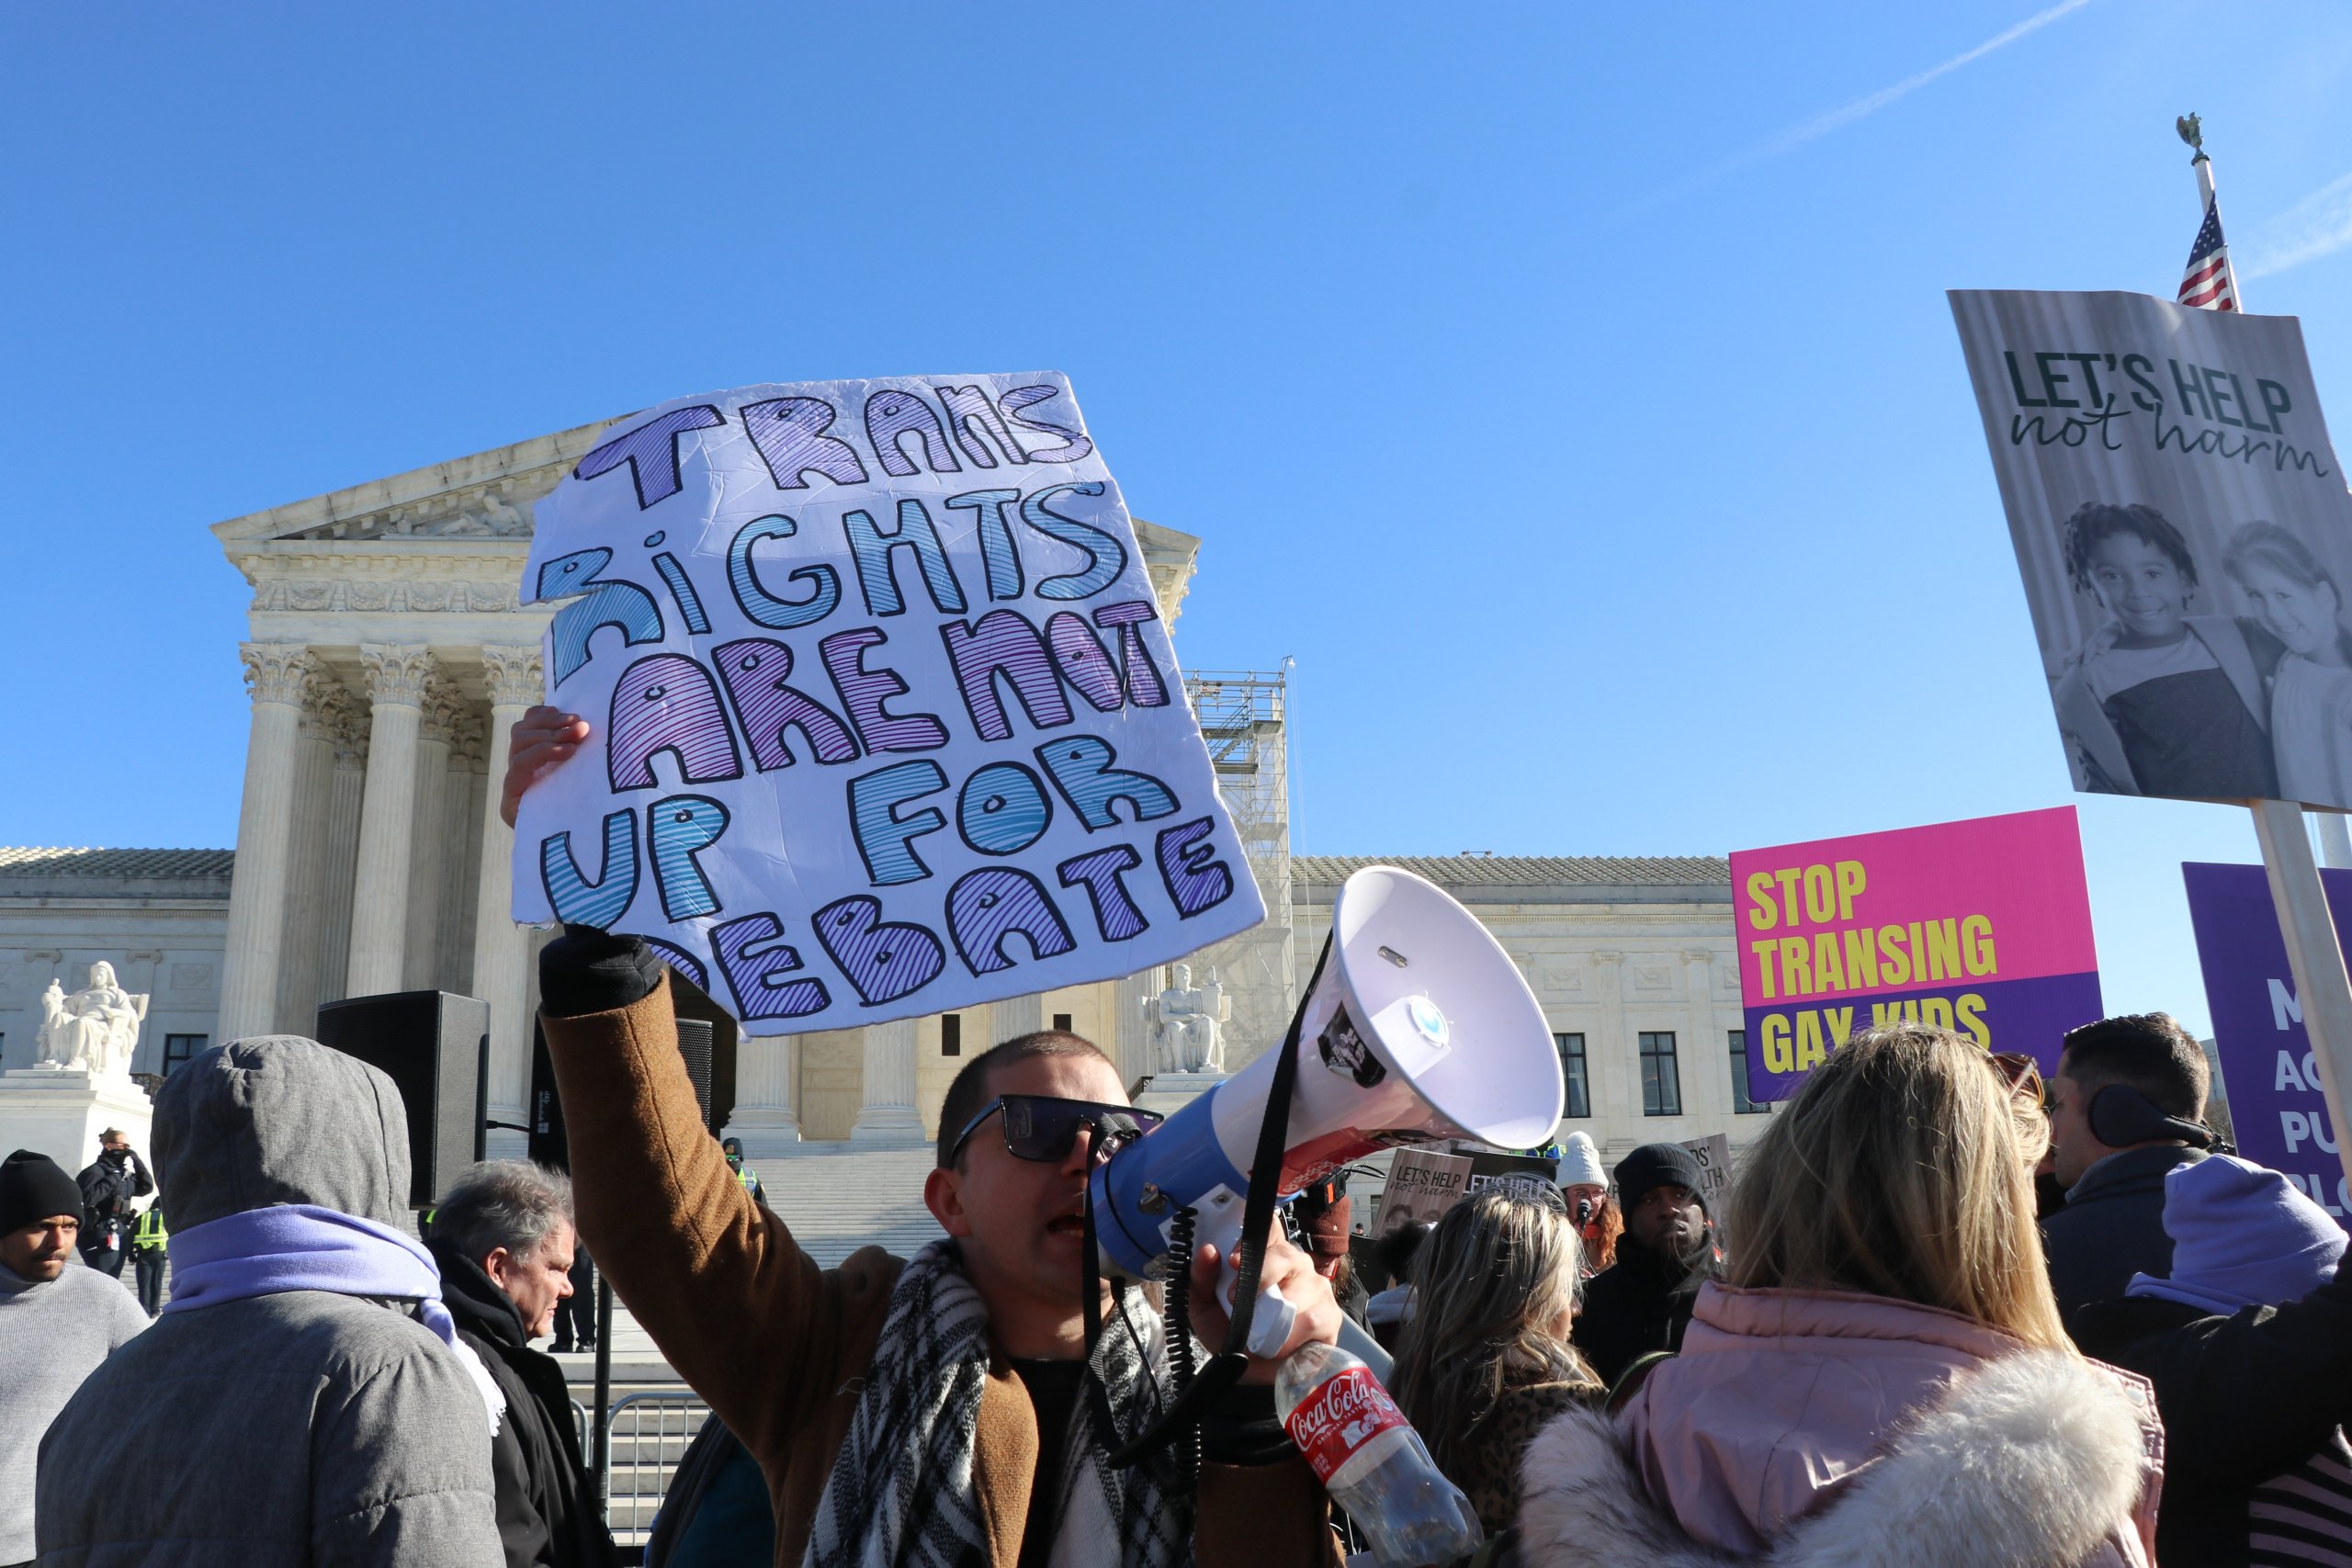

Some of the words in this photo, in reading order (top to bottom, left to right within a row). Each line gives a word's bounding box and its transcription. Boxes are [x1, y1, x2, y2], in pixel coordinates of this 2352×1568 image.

[2004, 351, 2163, 412] LET'S
[2168, 359, 2291, 434] HELP
[2011, 393, 2132, 450] not
[2154, 398, 2328, 478] harm
[607, 626, 949, 794] ARE
[540, 793, 731, 930] UP
[846, 734, 1182, 887] FOR
[1747, 860, 1868, 931] STOP
[1751, 914, 1997, 998] TRANSING
[1760, 1005, 1854, 1074] GAY
[1389, 1179, 1419, 1192] not
[1419, 1184, 1459, 1199] harm
[1396, 1165, 1430, 1185] LET'S
[1430, 1171, 1462, 1188] HELP
[1292, 1370, 1371, 1451] Coca-Cola
[1317, 1419, 1344, 1445] ORIGINAL
[1343, 1404, 1363, 1423] TASTE
